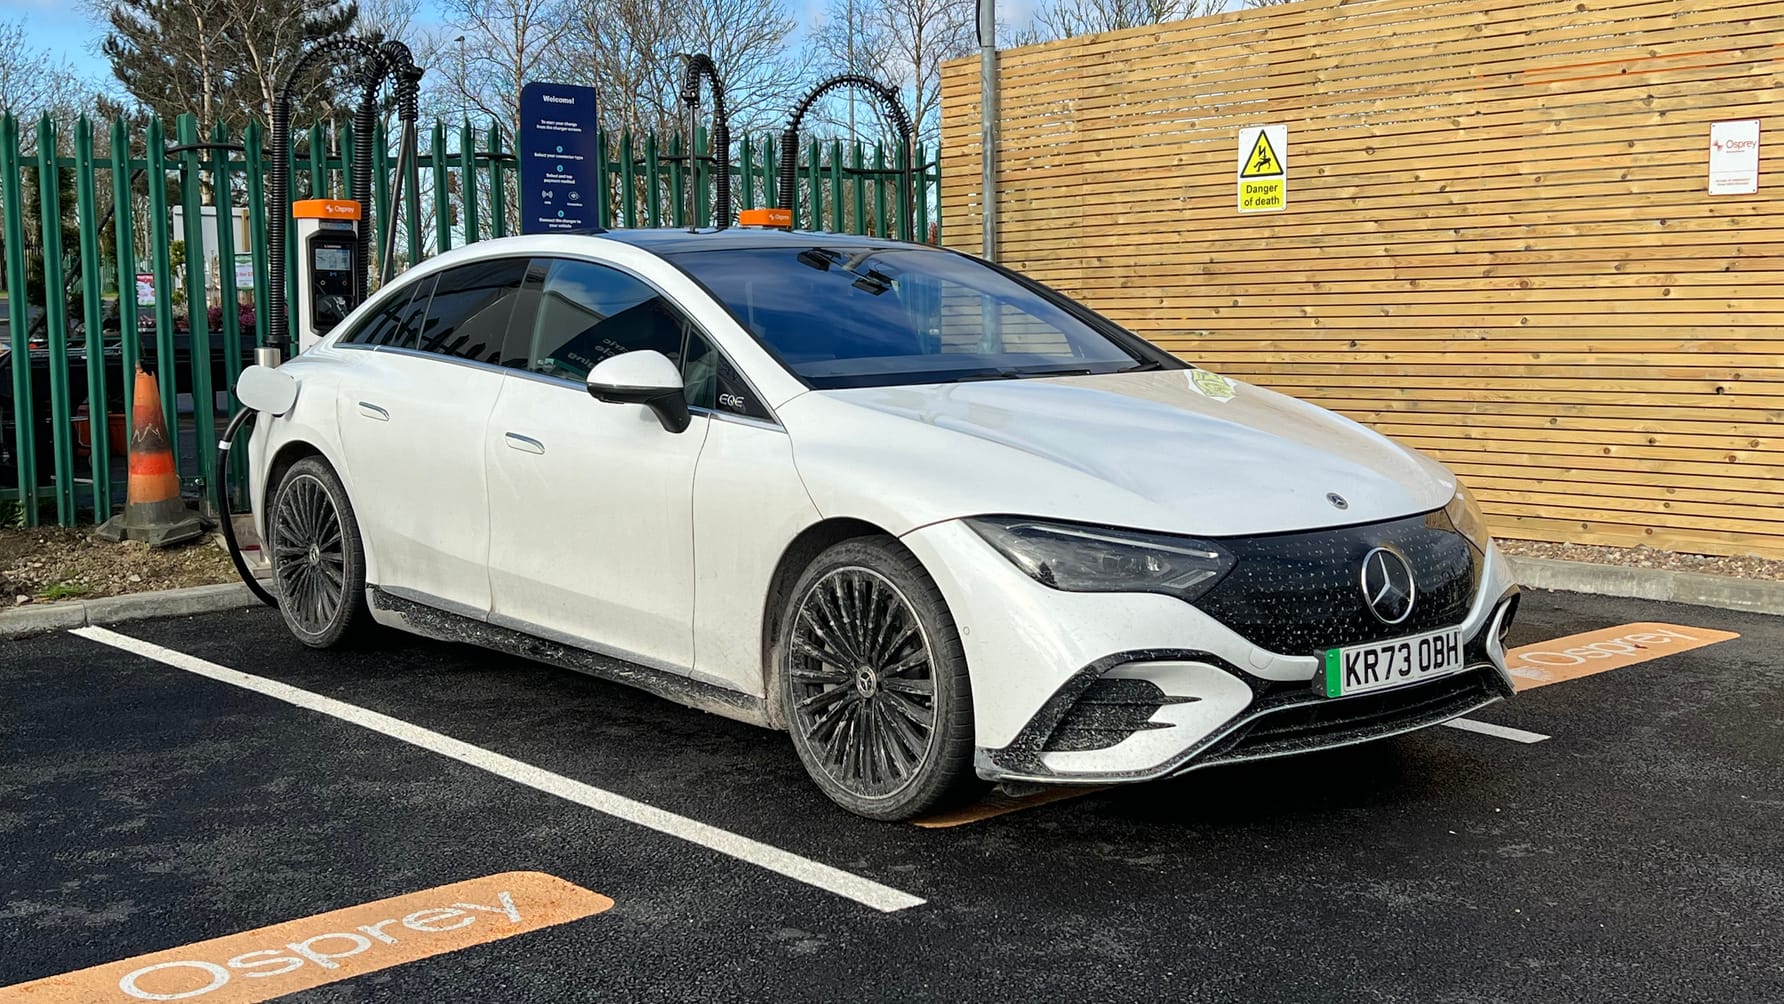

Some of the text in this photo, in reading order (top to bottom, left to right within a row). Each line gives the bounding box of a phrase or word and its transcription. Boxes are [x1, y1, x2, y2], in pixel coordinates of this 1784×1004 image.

[542, 95, 575, 104] Welcome!
[1725, 139, 1757, 150] Osprey
[1246, 184, 1278, 195] Danger
[1244, 195, 1280, 206] of death
[719, 393, 744, 408] EQE
[1518, 629, 1699, 666] Osprey
[1345, 631, 1459, 687] KR73 OBH
[118, 891, 522, 1001] Osprey
